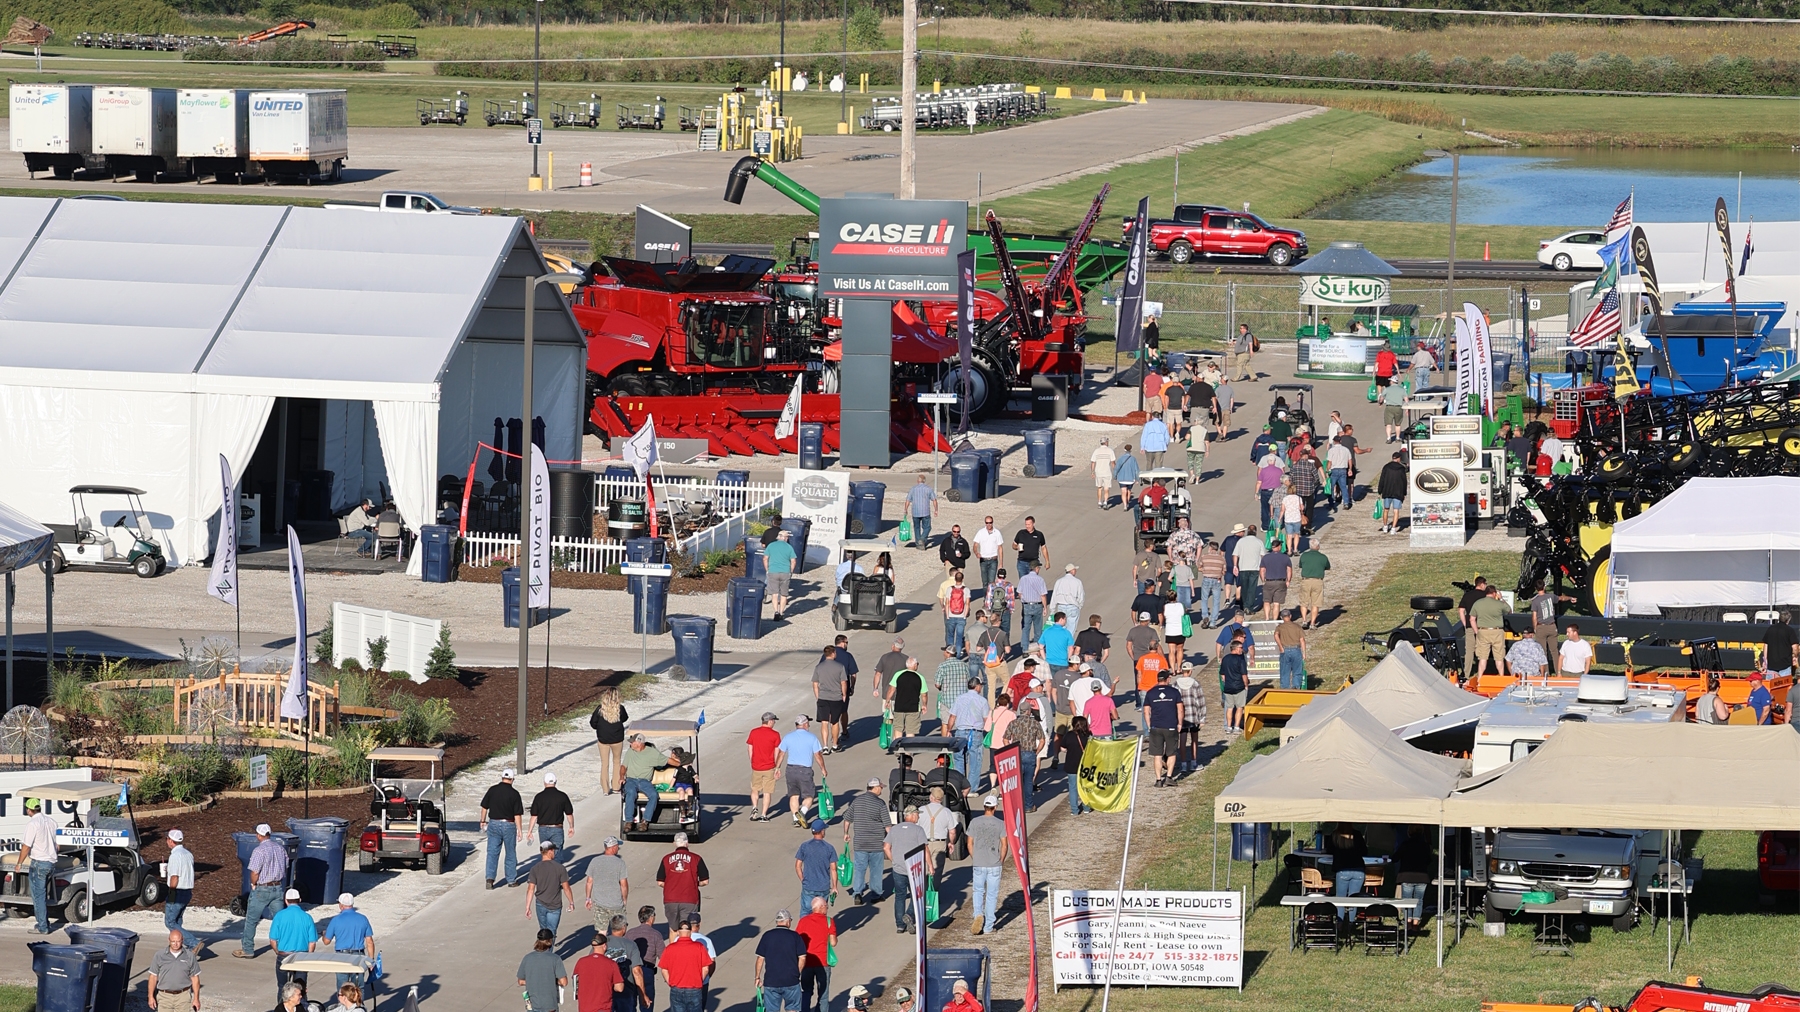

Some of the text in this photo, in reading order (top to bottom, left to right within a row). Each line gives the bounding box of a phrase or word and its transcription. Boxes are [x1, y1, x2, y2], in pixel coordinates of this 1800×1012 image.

[180, 99, 218, 108] Mayflower
[254, 100, 303, 111] UNITED
[840, 223, 924, 243] CASE
[887, 246, 946, 255] AGRICULTURE
[834, 278, 949, 291] Visit Us At CaseIH.com
[1318, 275, 1382, 301] Sukup
[1475, 319, 1486, 364] FARMING
[794, 486, 837, 497] SQUARE
[816, 514, 838, 524] Tent
[533, 515, 542, 569] PIVOT
[223, 526, 232, 574] PIVOT
[1224, 802, 1240, 812] GO
[72, 837, 112, 846] MUSCO
[669, 854, 691, 864] INDIAN
[1063, 896, 1232, 908] CUSTOM MADE PRODUCTS
[1088, 920, 1112, 929] Gary,
[1064, 931, 1106, 940] Scrapers,
[1080, 952, 1125, 961] anytime
[1164, 952, 1238, 961] 515-332-1875
[1704, 1002, 1738, 1012] RITEWAY
